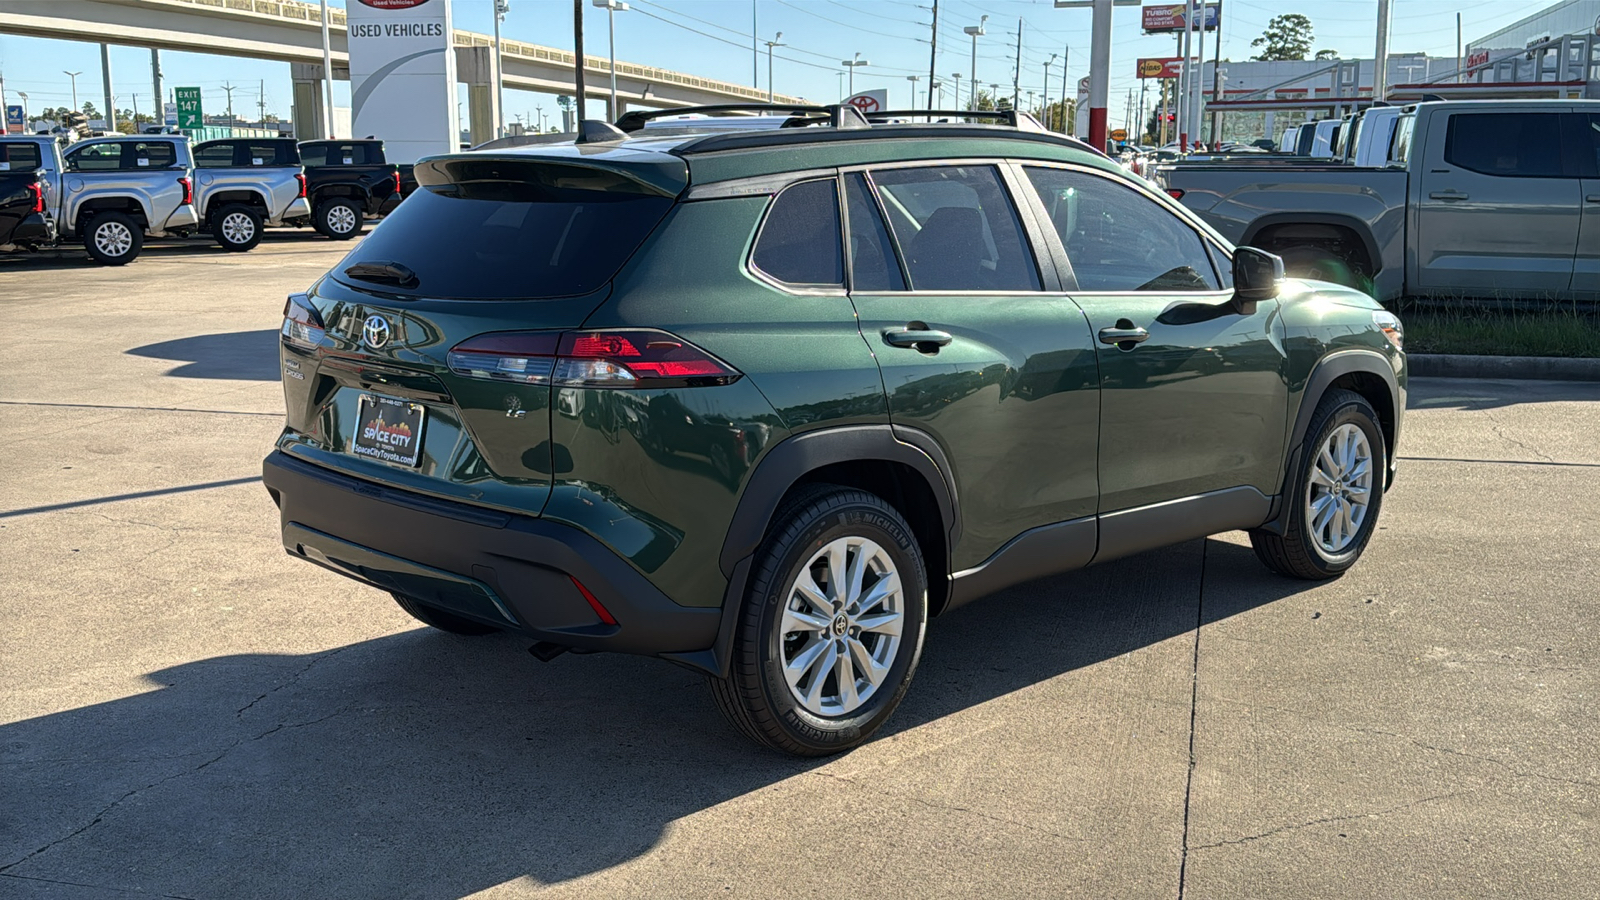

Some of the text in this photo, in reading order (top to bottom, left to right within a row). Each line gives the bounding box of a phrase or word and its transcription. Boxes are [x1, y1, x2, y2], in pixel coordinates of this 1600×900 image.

[351, 23, 442, 37] USED VEHICLES
[180, 101, 197, 111] 147
[364, 426, 411, 447] SPACE CITY
[355, 444, 414, 464] SpaceCityToyota.com
[863, 513, 909, 548] MICHELIN
[786, 711, 838, 741] MICHELIN
